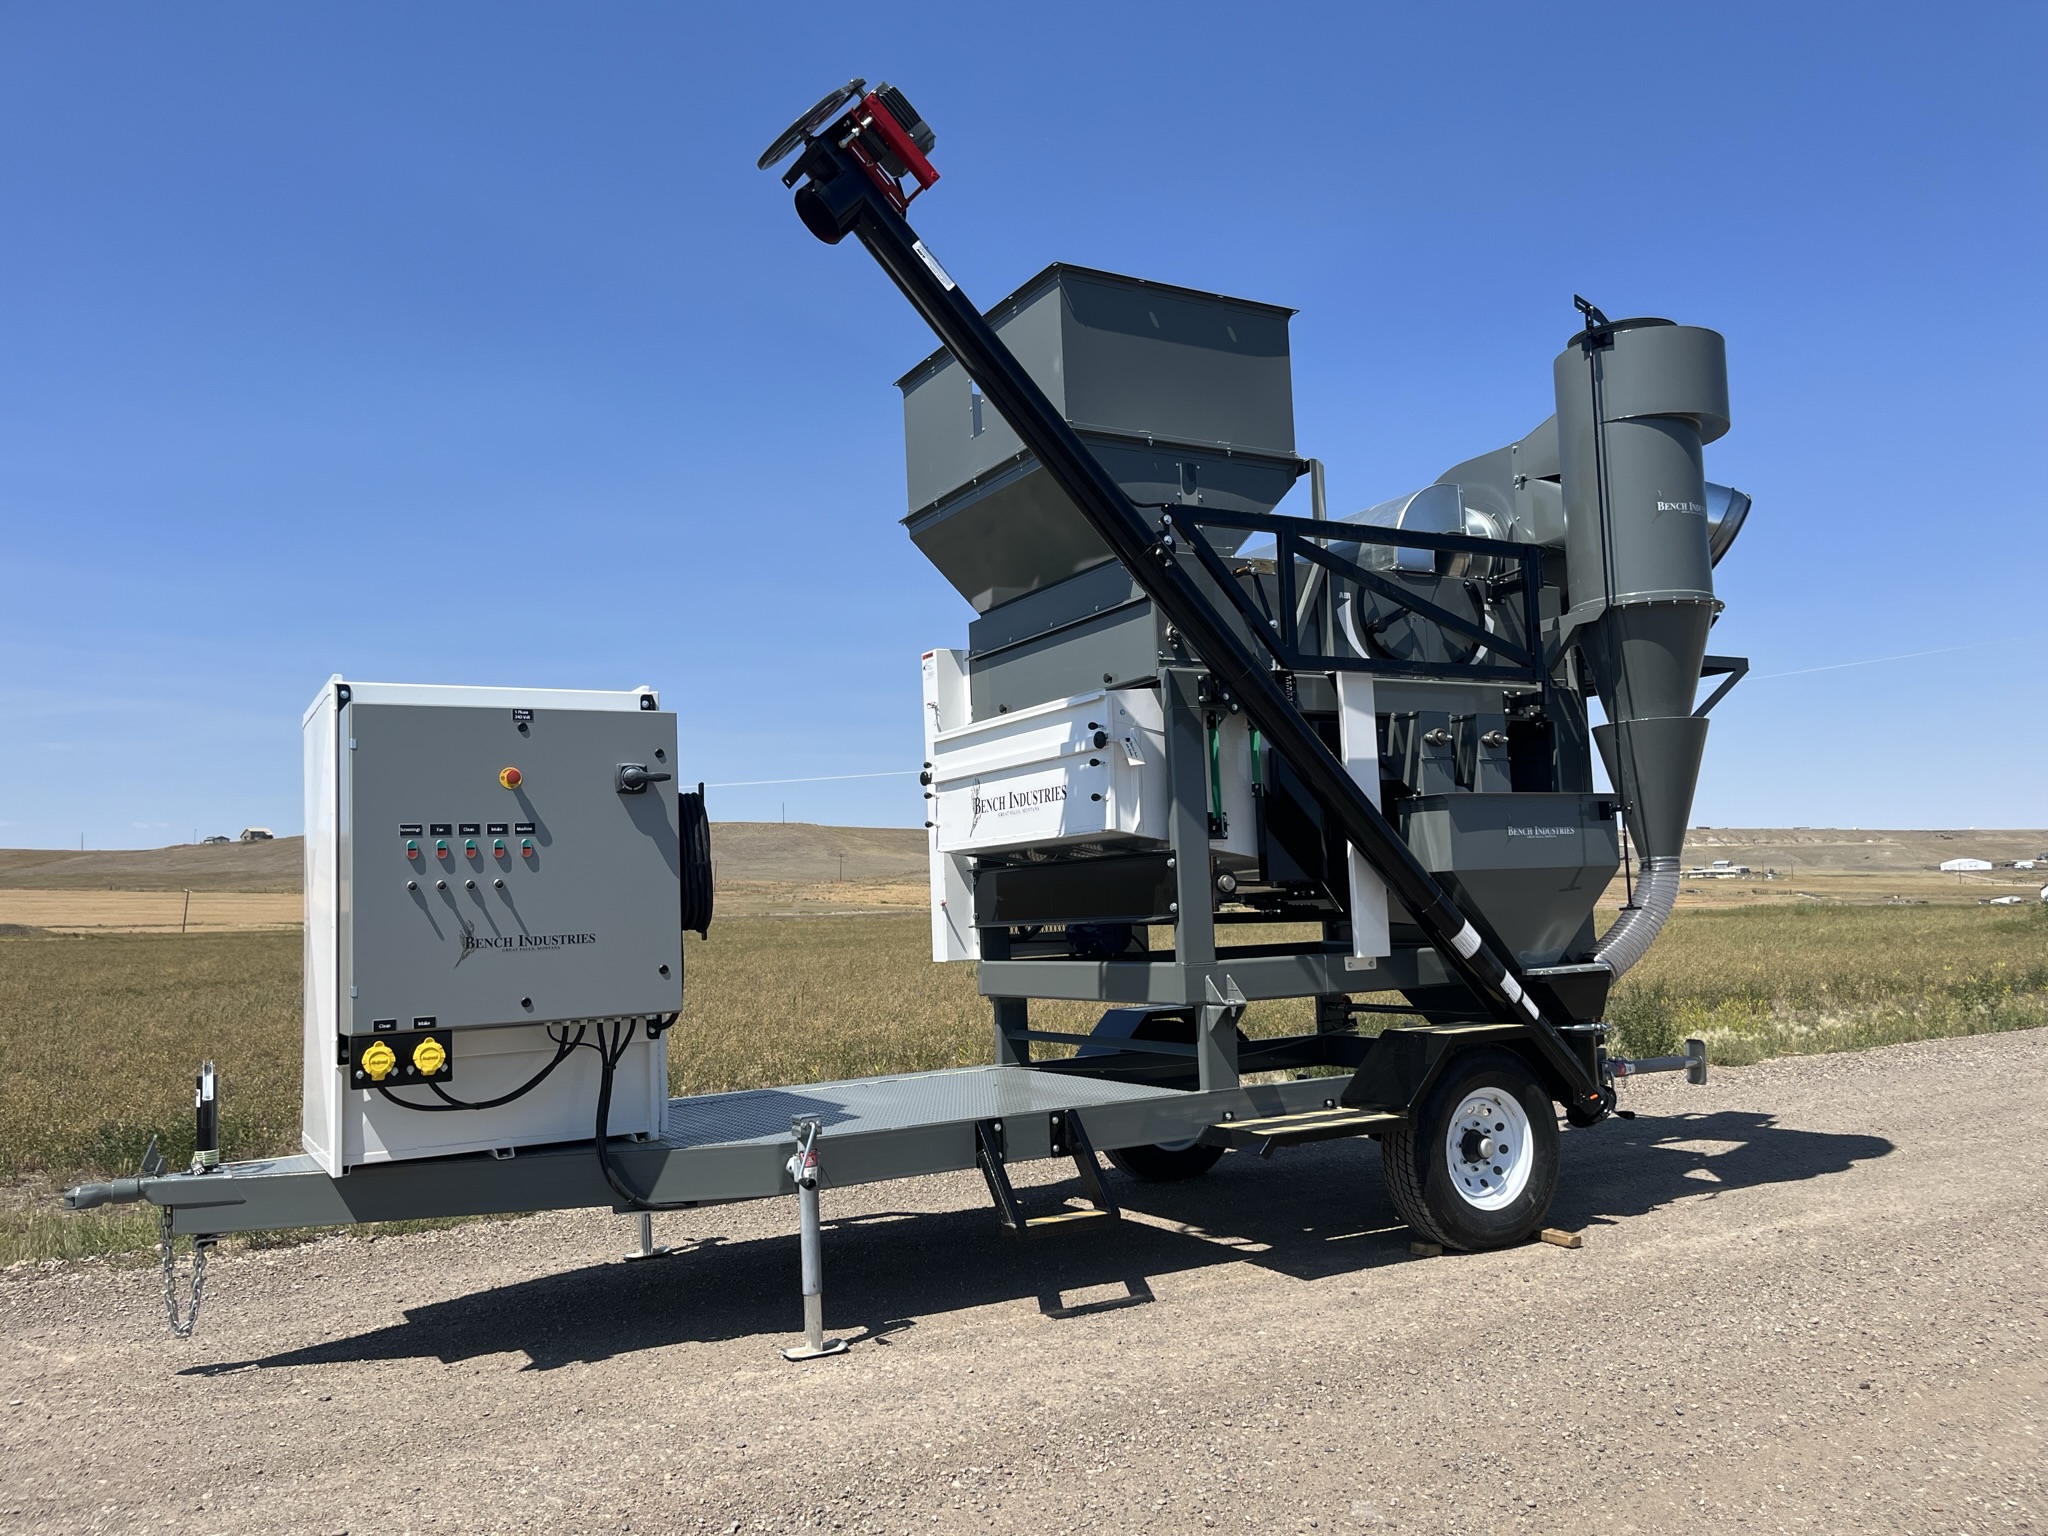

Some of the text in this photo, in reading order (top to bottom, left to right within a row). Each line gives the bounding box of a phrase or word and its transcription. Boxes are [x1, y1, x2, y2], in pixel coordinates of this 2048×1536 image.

[1657, 501, 1687, 511] BENCH
[975, 784, 1067, 815] BENCH INDUSTRIES
[1507, 825, 1575, 836] BENCH INDUSTRIES
[465, 933, 596, 949] BENCH INDUSTRIES
